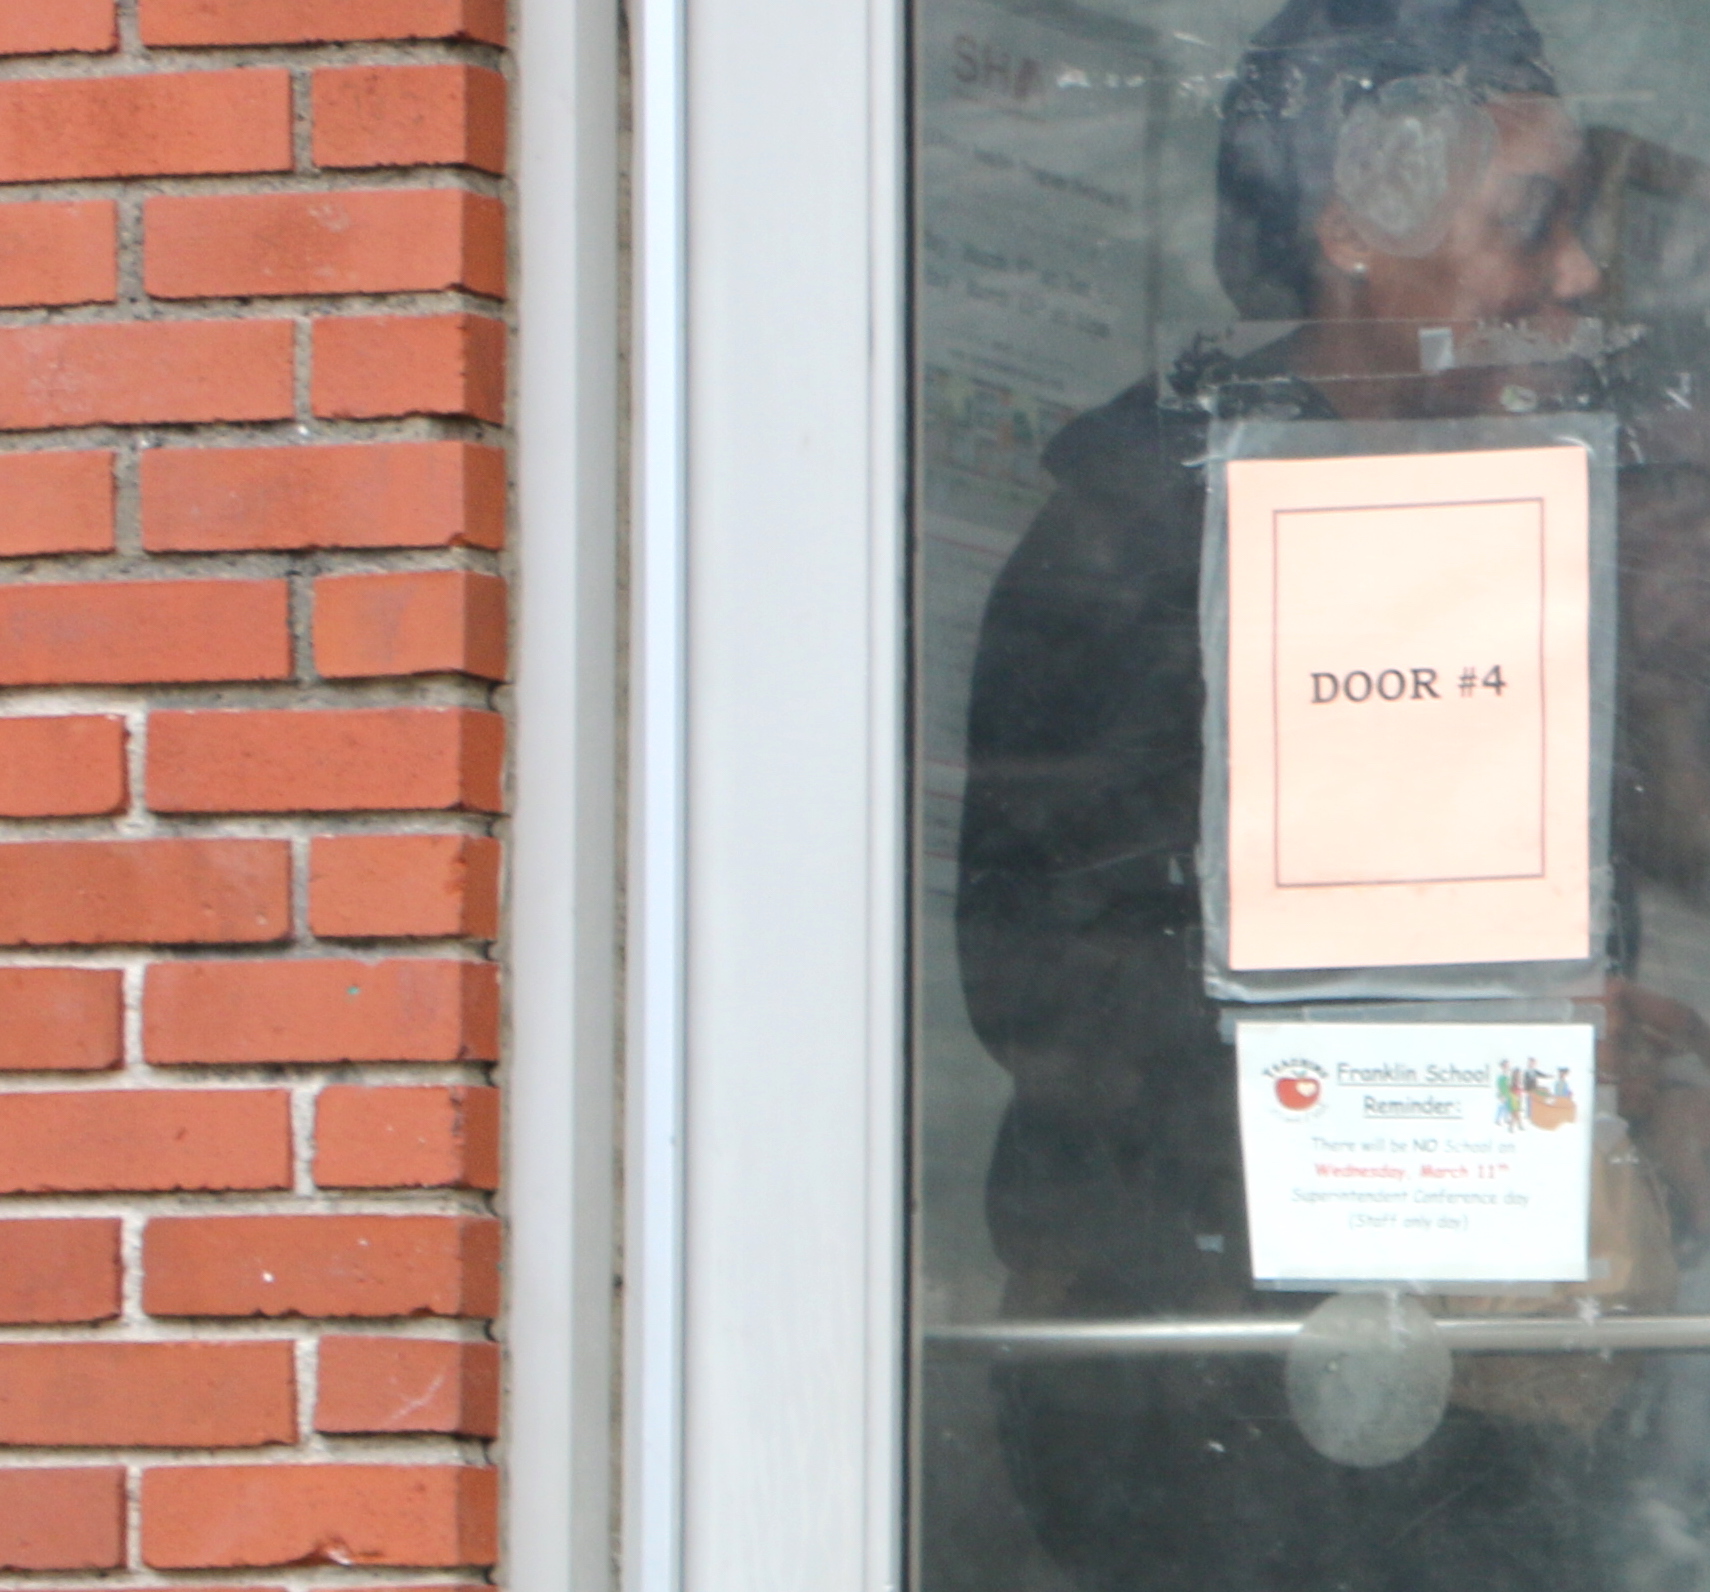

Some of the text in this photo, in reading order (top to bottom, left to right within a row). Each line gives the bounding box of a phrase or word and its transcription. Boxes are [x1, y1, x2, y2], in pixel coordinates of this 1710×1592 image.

[1310, 664, 1508, 704] DOOR #4
[1336, 1062, 1491, 1085] Franklin School
[1363, 1095, 1462, 1116] Reminder:
[1311, 1137, 1356, 1153] There
[1360, 1137, 1387, 1153] will
[1390, 1137, 1408, 1153] be
[1412, 1137, 1439, 1153] NO
[1443, 1137, 1493, 1153] School
[1419, 1163, 1469, 1179] March
[1291, 1187, 1530, 1207] Superintendent Conference day
[1402, 1214, 1433, 1231] only
